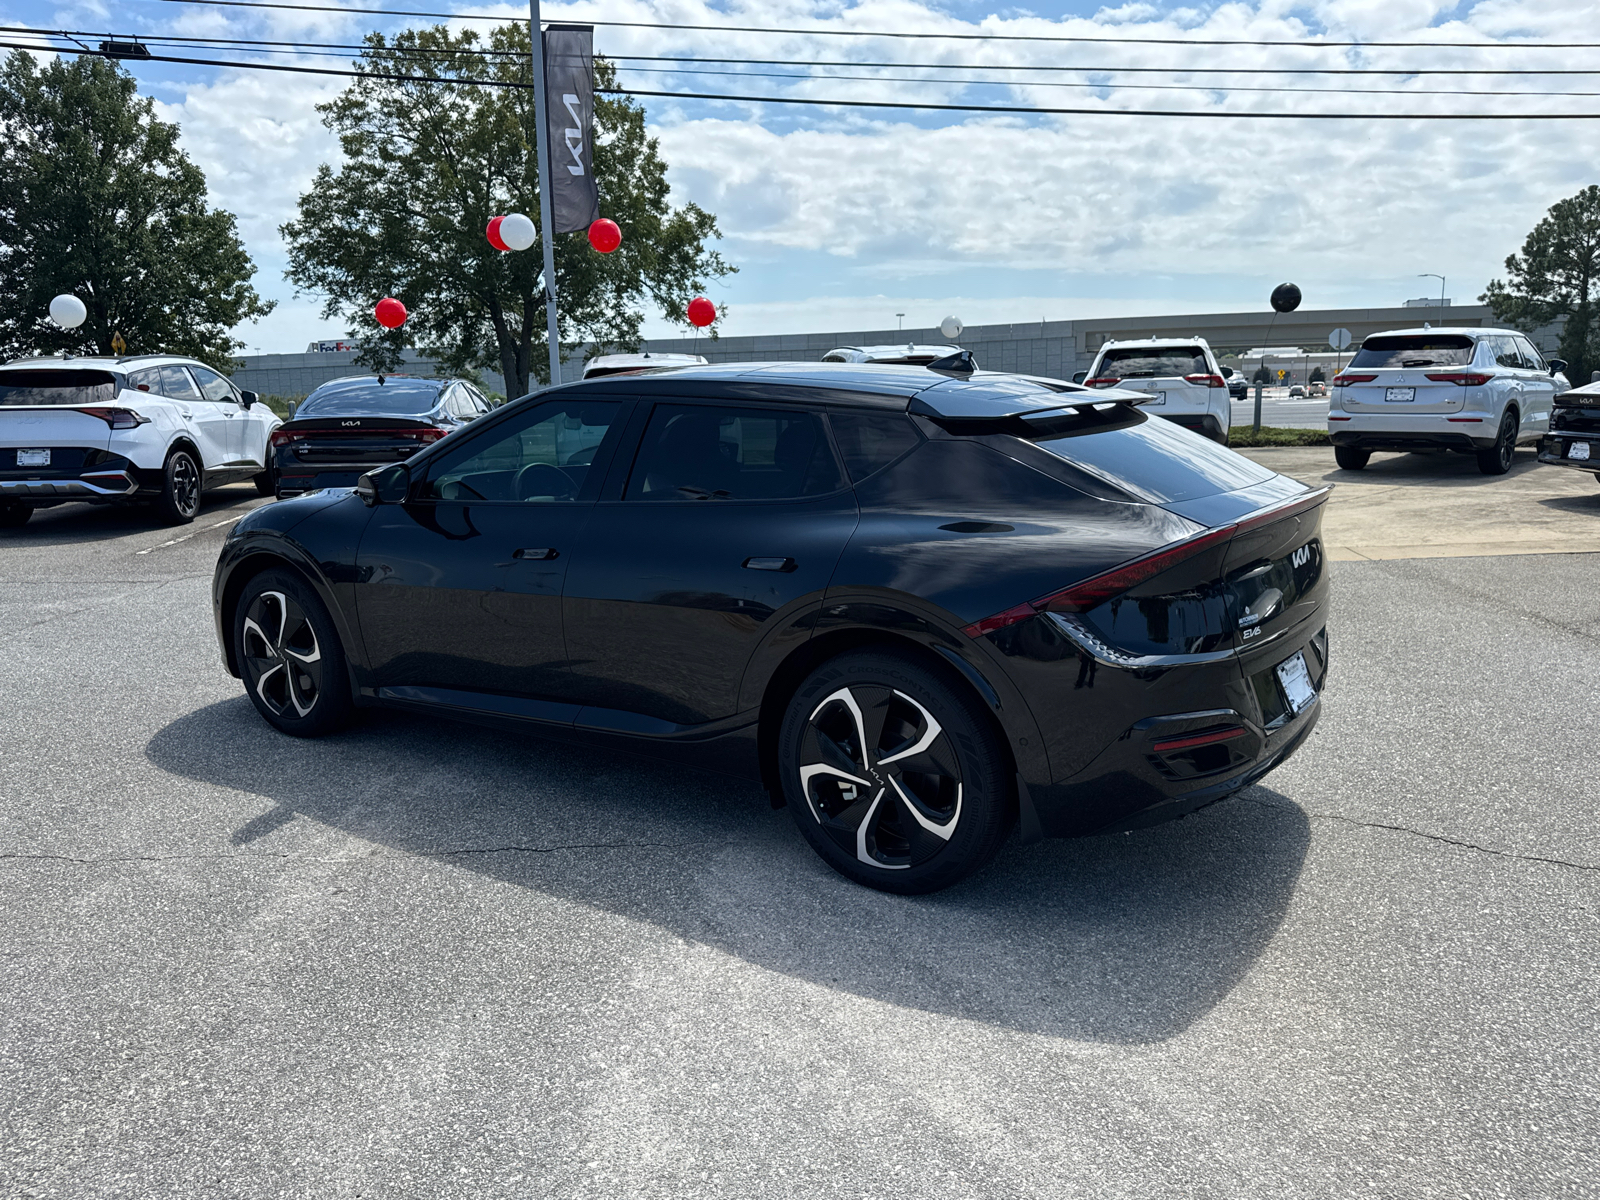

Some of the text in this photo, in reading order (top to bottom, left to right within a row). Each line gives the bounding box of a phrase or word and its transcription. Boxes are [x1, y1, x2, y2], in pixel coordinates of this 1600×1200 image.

[563, 93, 585, 176] KIA
[1292, 544, 1310, 568] KIA
[1243, 625, 1262, 640] EV6
